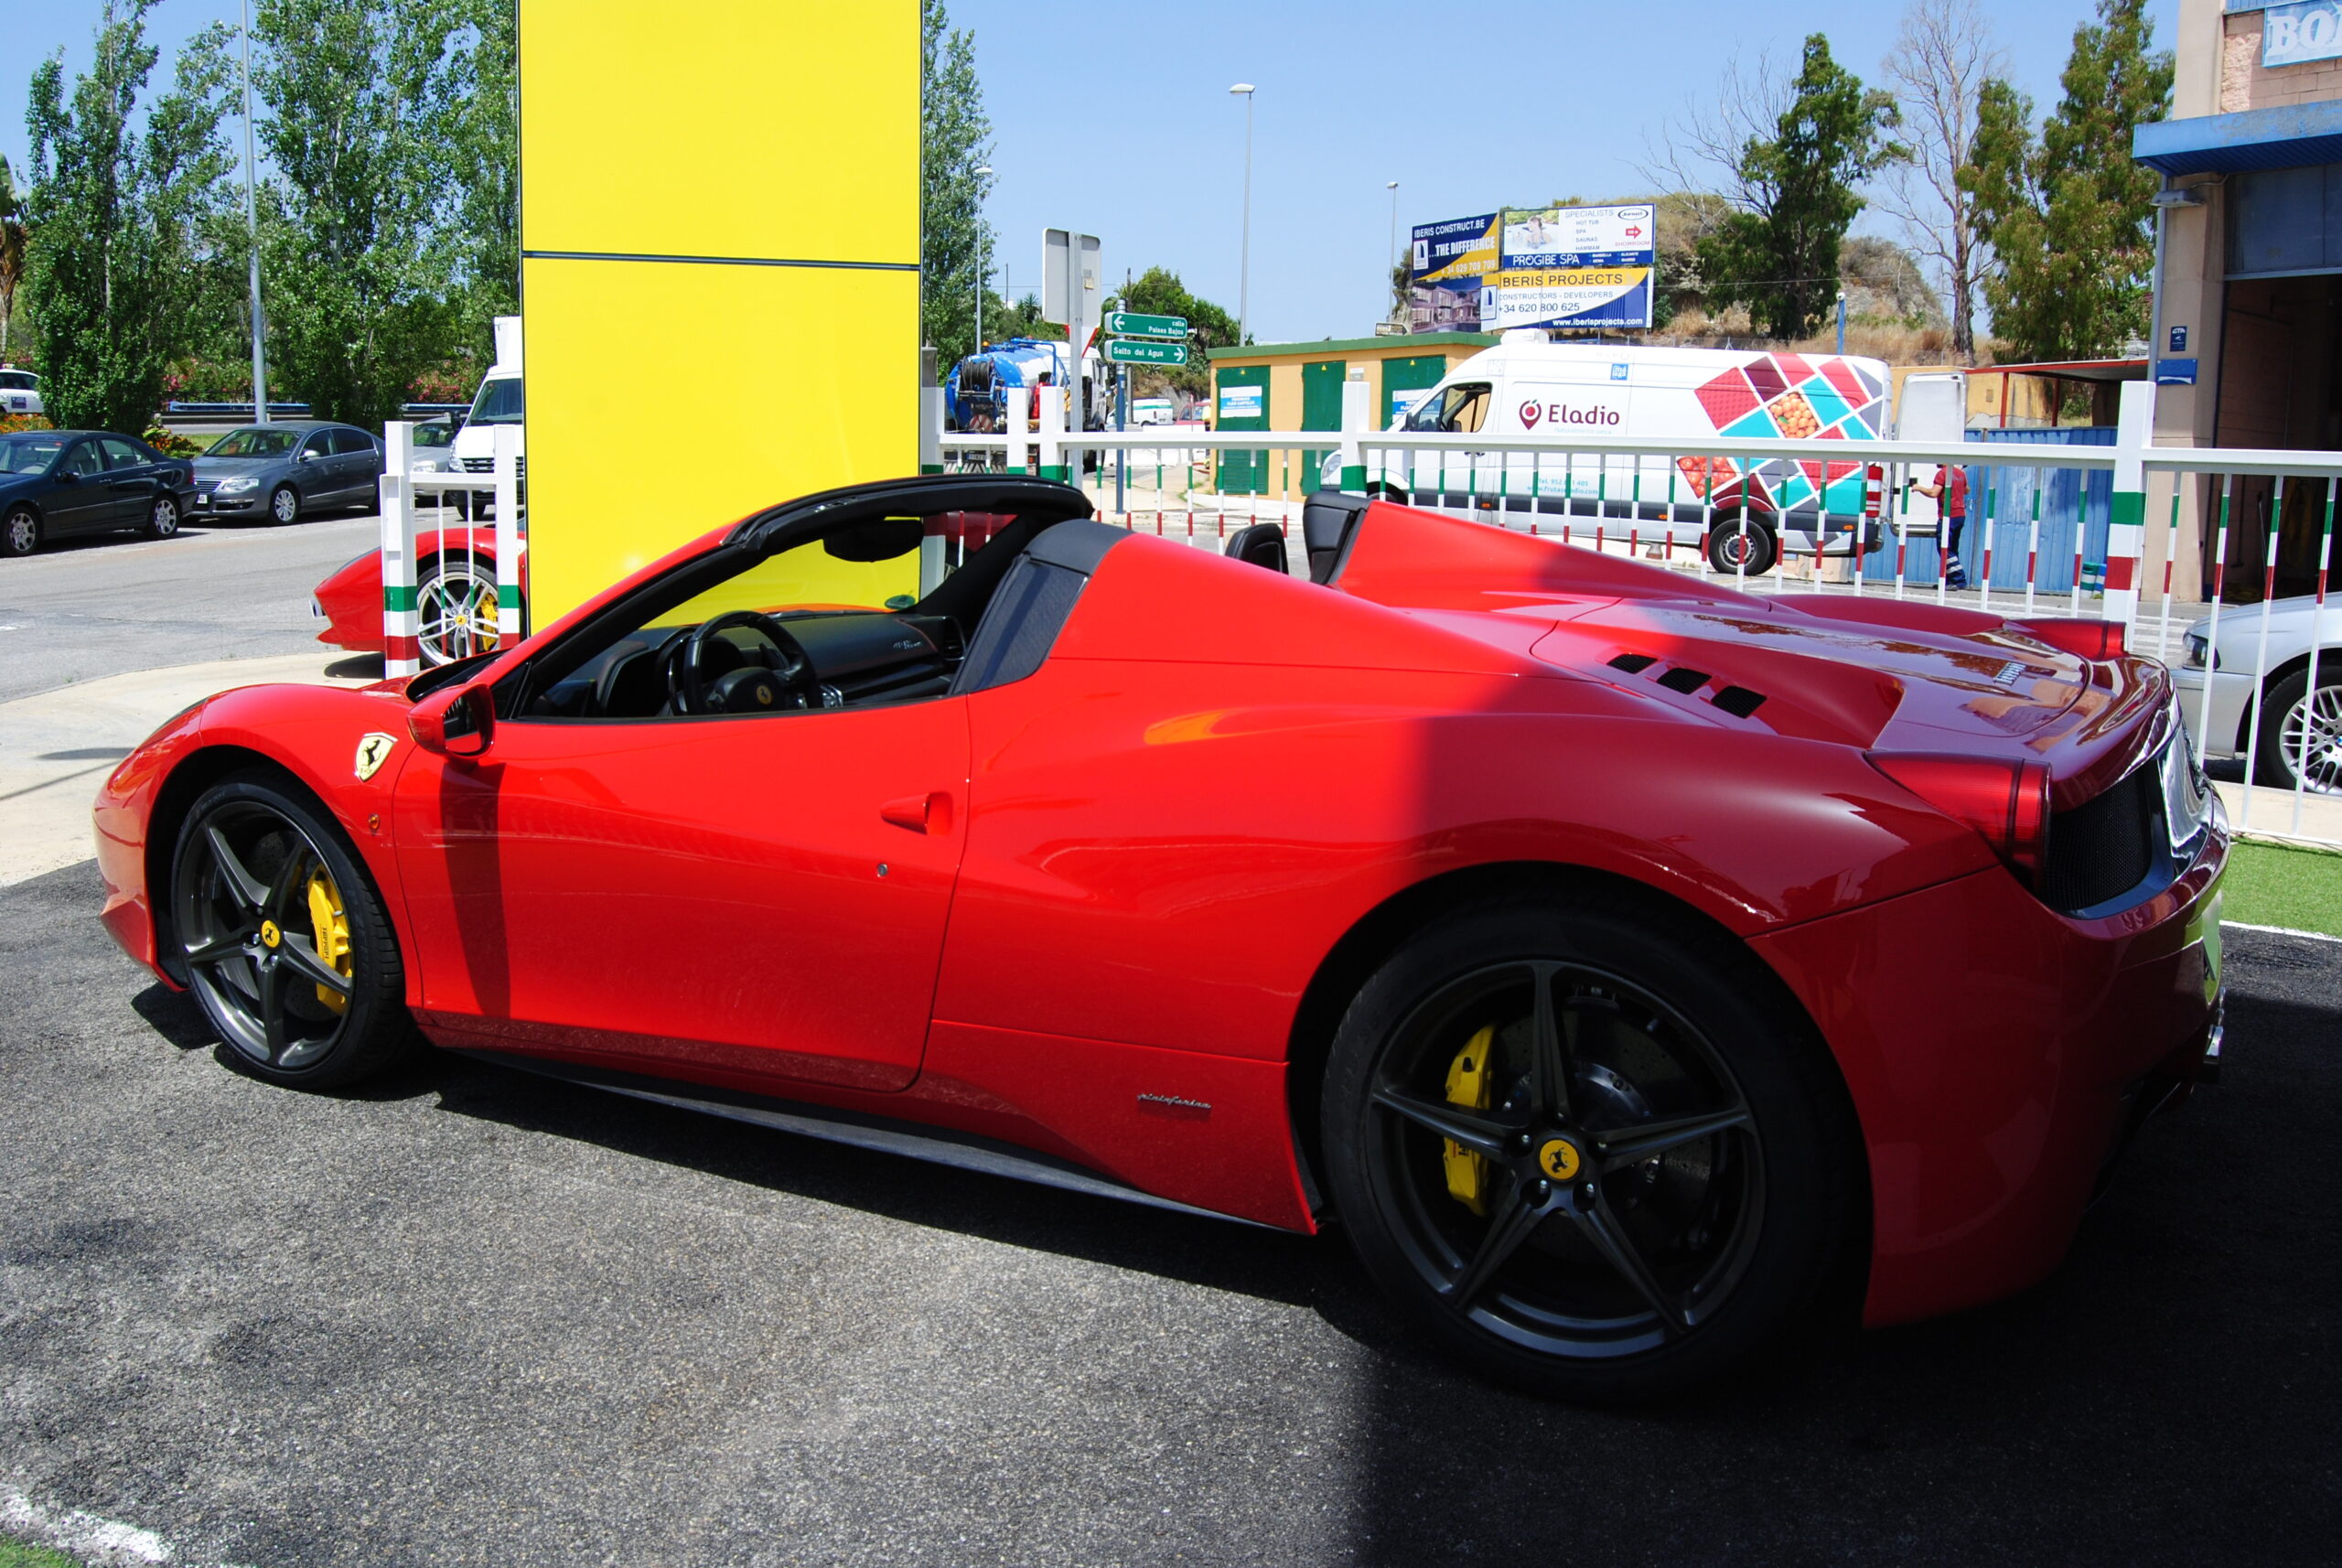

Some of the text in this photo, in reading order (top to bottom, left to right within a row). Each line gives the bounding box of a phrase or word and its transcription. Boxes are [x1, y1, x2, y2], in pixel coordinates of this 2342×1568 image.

[2266, 2, 2342, 56] BO
[1565, 209, 1614, 218] SPECIALISTS
[1414, 219, 1485, 238] IBERIS CONSTRUCT.BE
[1451, 236, 1495, 254] DIFFERENCE
[1483, 260, 1496, 270] 709
[1512, 253, 1580, 266] PROGIBE SPA
[1548, 274, 1623, 285] PROJECTS
[1499, 293, 1558, 301] CONSTRUCTORS
[1563, 291, 1614, 299] DEVELOPERS
[1499, 305, 1516, 313] +34
[1519, 304, 1538, 312] 620
[1540, 303, 1558, 312] 800
[1561, 303, 1580, 311] 625
[1552, 317, 1643, 327] www.iberisprojects.com
[1168, 327, 1184, 336] Bajos
[1113, 347, 1131, 355] Salto
[1148, 349, 1164, 358] Agua
[1548, 404, 1620, 425] Eladio
